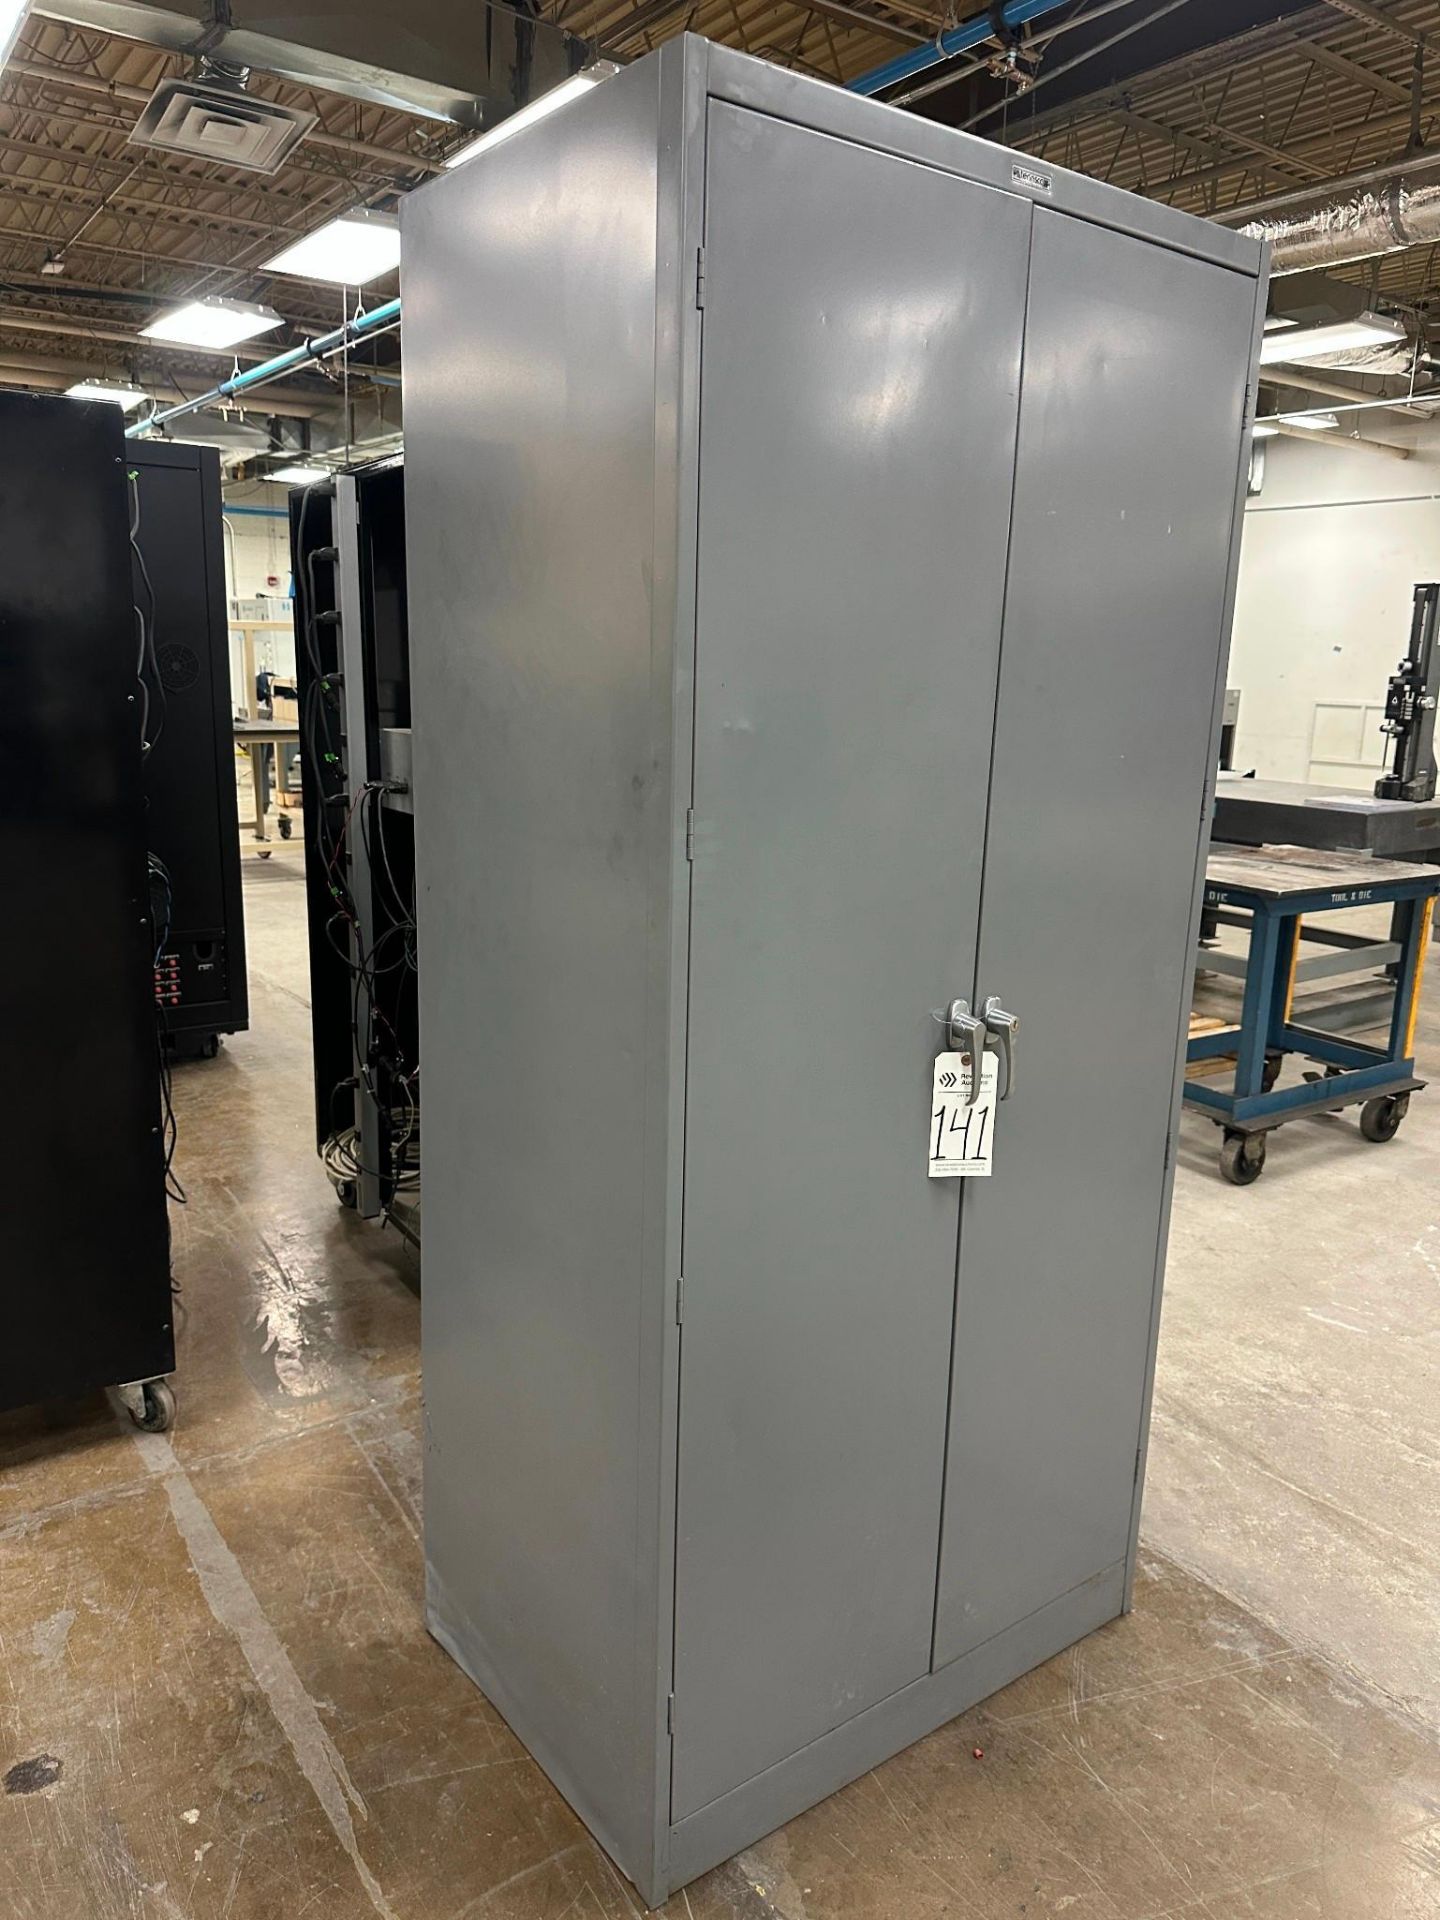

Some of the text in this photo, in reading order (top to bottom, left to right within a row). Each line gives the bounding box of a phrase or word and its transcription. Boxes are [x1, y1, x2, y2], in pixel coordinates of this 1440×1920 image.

[1208, 890, 1228, 903] DIE
[1358, 890, 1372, 900] DIE
[930, 1105, 989, 1160] 141
